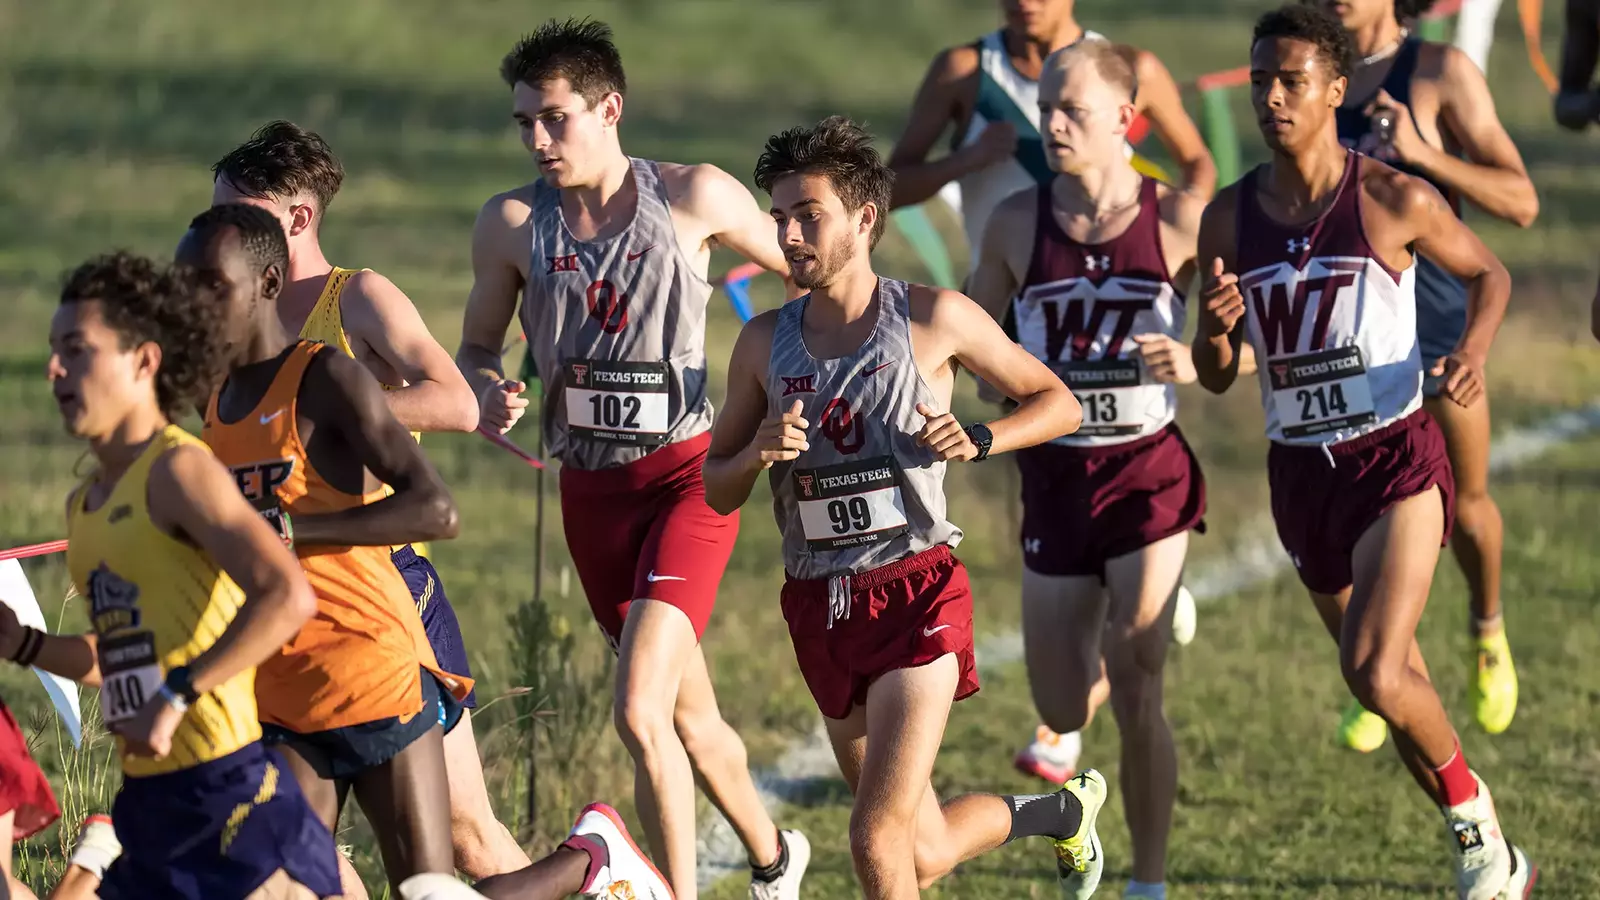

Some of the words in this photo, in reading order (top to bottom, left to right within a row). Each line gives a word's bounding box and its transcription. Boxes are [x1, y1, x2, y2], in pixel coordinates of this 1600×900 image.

[546, 252, 580, 275] XII
[1041, 298, 1154, 361] WT
[1252, 273, 1356, 357] WT
[593, 371, 631, 383] TEXAS
[632, 372, 664, 384] TECH
[1293, 362, 1329, 378] TEXAS
[1328, 355, 1360, 372] TECH
[781, 373, 816, 397] XII
[589, 394, 642, 429] 102
[1074, 391, 1118, 422] 13
[1296, 383, 1348, 421] 214
[229, 458, 295, 499] EP
[820, 472, 859, 489] TEXAS
[859, 467, 892, 483] TECH
[827, 496, 872, 534] 99
